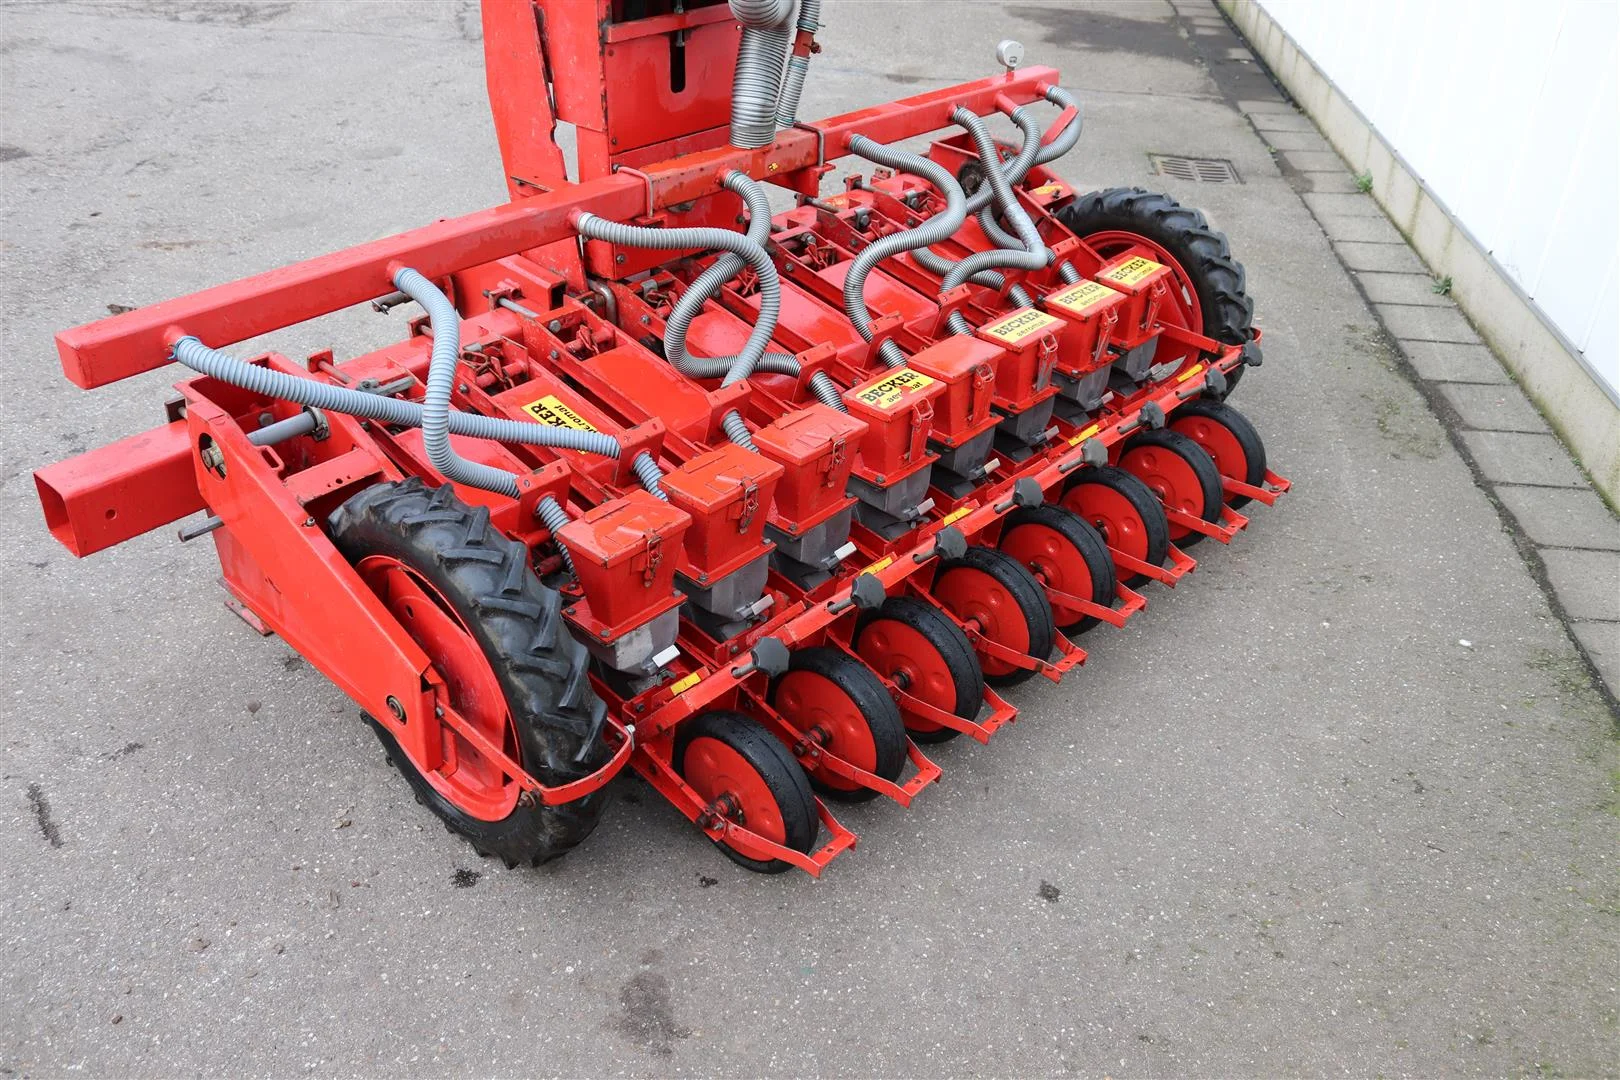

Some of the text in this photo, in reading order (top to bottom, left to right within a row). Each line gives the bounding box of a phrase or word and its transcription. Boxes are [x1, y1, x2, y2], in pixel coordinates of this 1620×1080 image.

[1110, 259, 1148, 280] BECKER
[1060, 283, 1102, 304] BECKER
[993, 311, 1043, 336] BECKER
[860, 372, 919, 402] BECKER
[531, 403, 572, 429] KER
